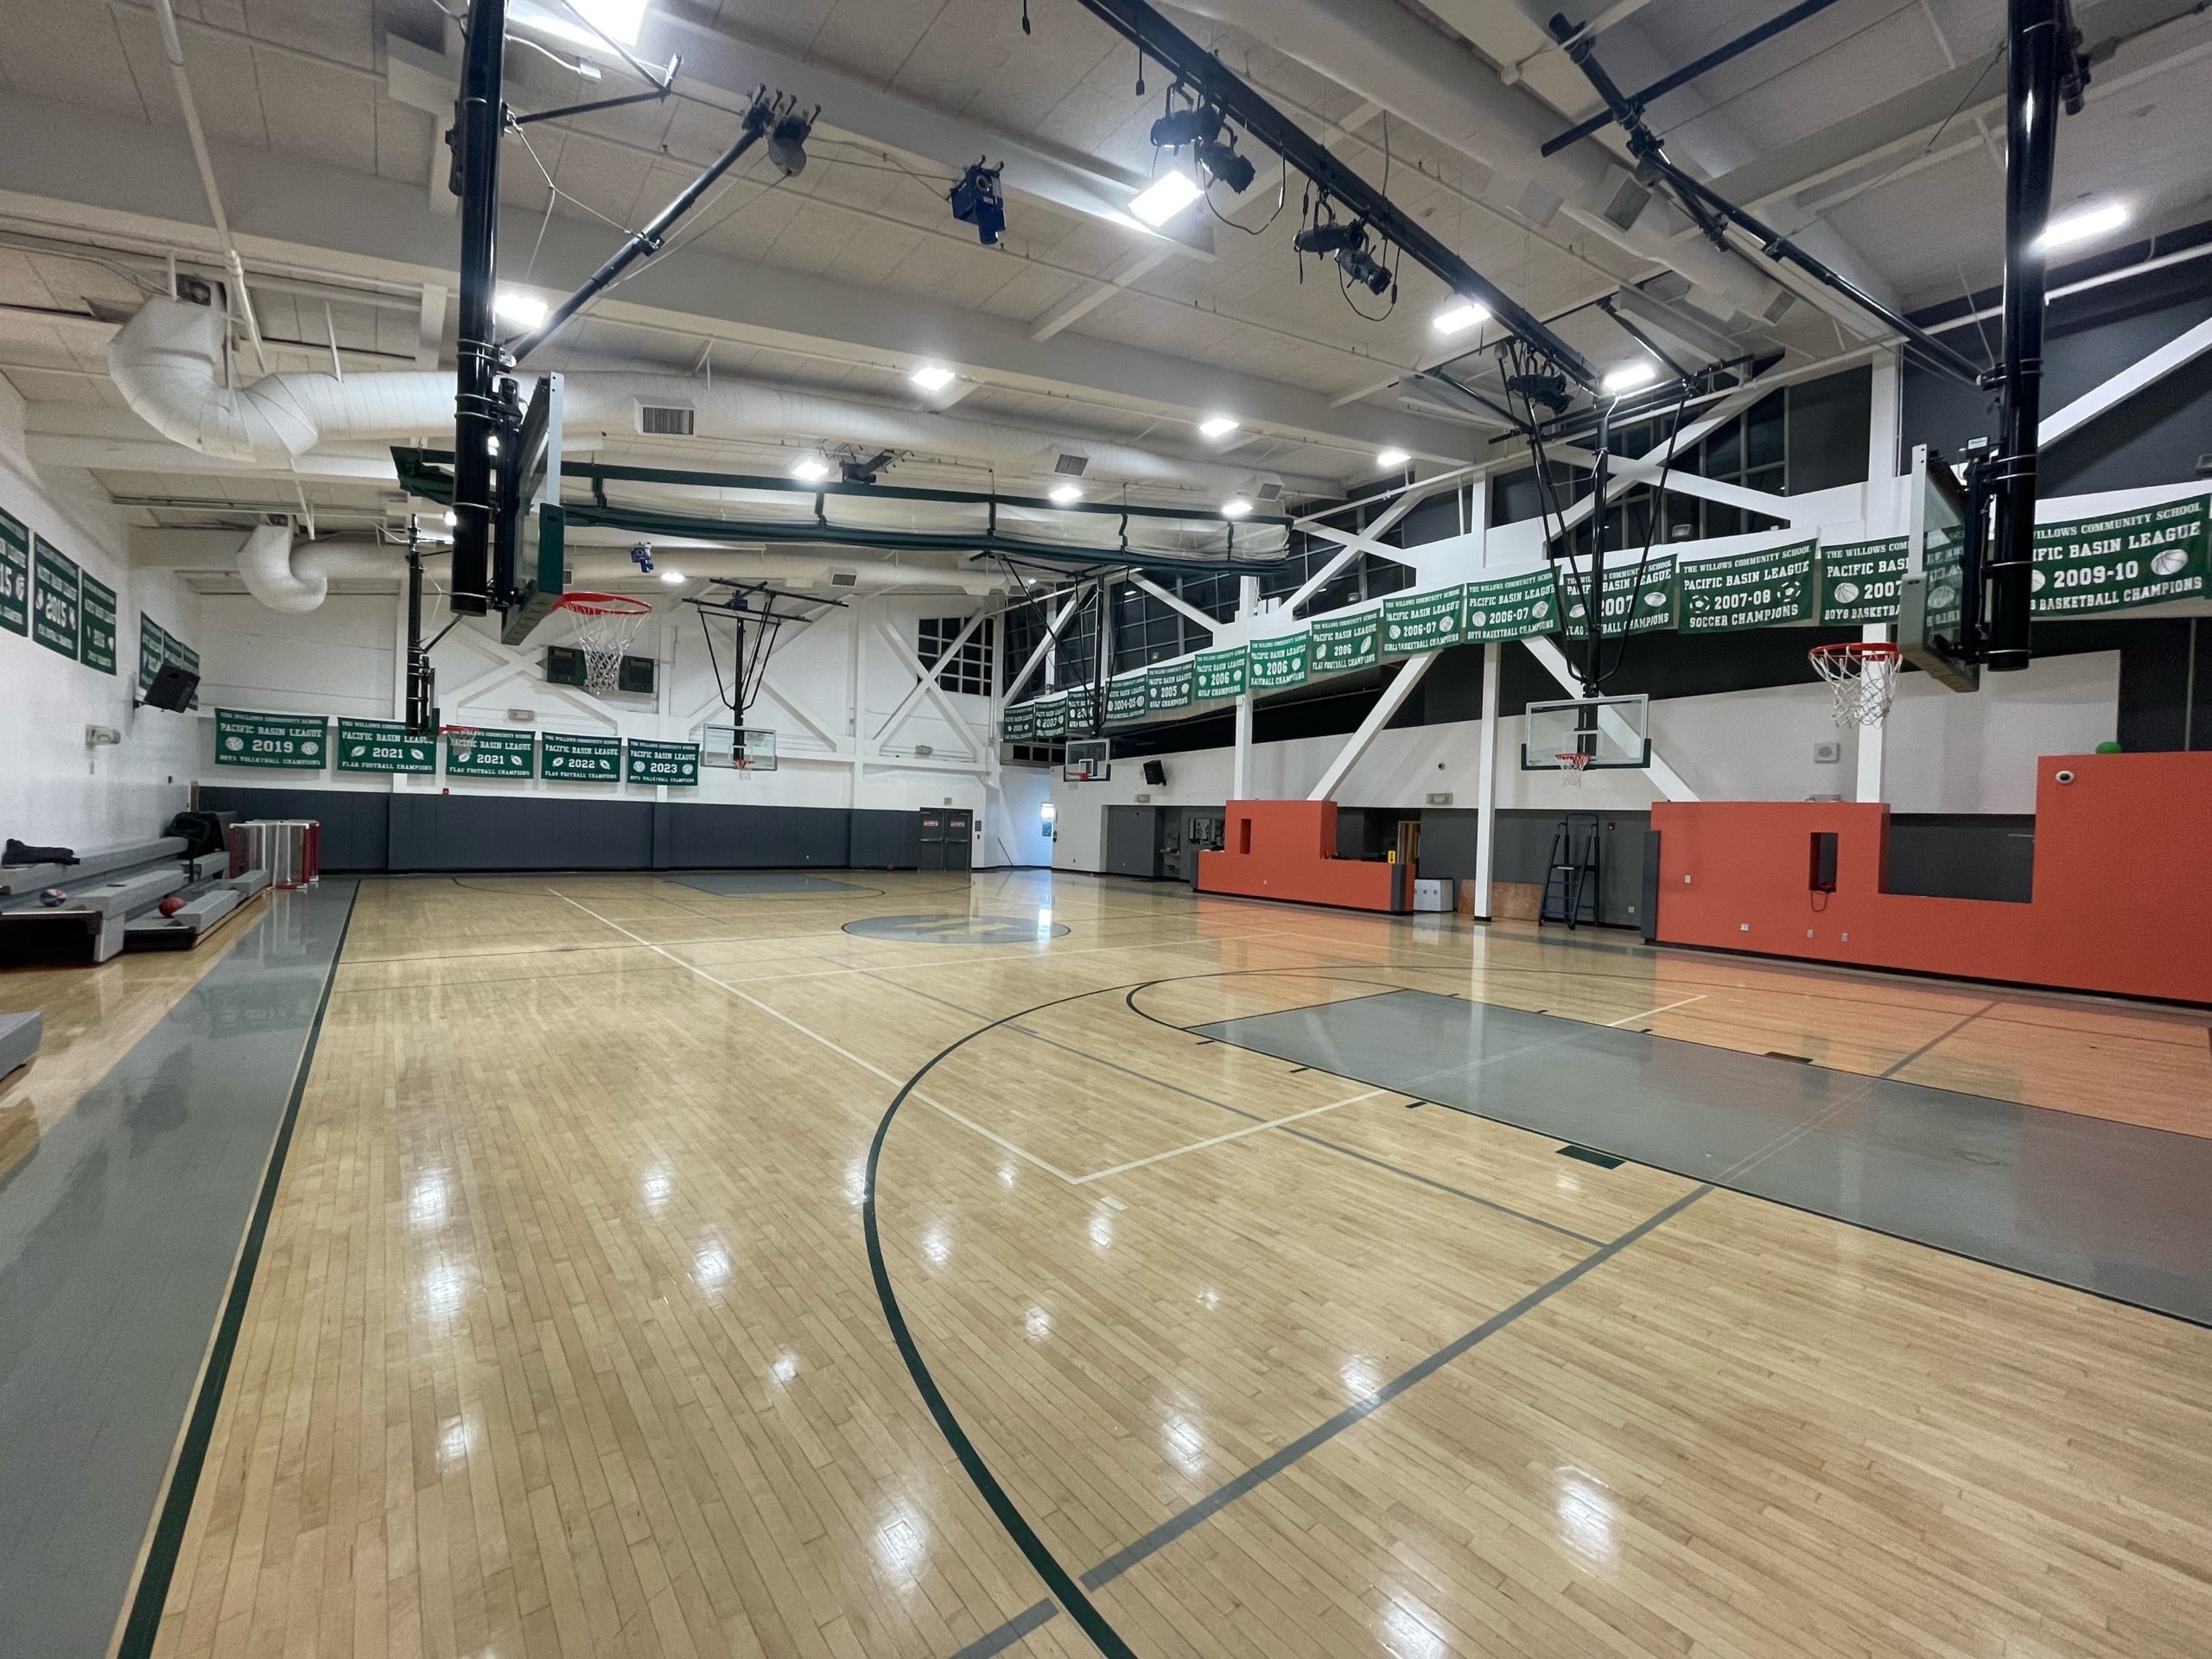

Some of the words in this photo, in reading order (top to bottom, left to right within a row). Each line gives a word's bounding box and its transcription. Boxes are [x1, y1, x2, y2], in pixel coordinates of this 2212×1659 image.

[2033, 526, 2077, 539] ILLOWS
[2081, 513, 2153, 534] COMMUNITY
[2156, 502, 2202, 521] SCHOOL
[2069, 538, 2121, 558] BASIN
[2128, 521, 2201, 549] LEAGUE
[1700, 562, 1732, 571] WILLOWS
[1735, 552, 1779, 567] COMMUNITY
[1782, 545, 1810, 558] SCHOOL
[1826, 550, 1843, 559] THE
[1846, 545, 1886, 557] WILLOWS
[1649, 560, 1672, 572] SCHOOL
[1827, 563, 1874, 577] PACIFIC
[1684, 577, 1722, 590] PACIFIC
[1726, 571, 1760, 586] BASIN
[1764, 561, 1809, 580] LEAGUE
[2054, 561, 2138, 588] 2009-10
[1505, 577, 1536, 588] COMMUNITY
[1602, 578, 1630, 592] BASIN
[1470, 596, 1496, 607] PACIFIC
[1499, 592, 1522, 604] BASIN
[1525, 584, 1555, 600] LEAGUE
[1714, 589, 1771, 610] 2007-08
[2040, 591, 2119, 611] BASKETBALL
[2124, 576, 2202, 602] CHAMPIONS
[1386, 612, 1409, 621] PACIFIC
[1411, 608, 1430, 619] BASIN
[1433, 601, 1460, 615] LEAGUE
[1489, 607, 1529, 624] 2006-07
[1690, 615, 1727, 628] SOCCER
[1732, 604, 1798, 625] CHAMPIONS
[1825, 609, 1848, 620] BOYS
[1313, 633, 1333, 641] PACIFIC
[1335, 630, 1352, 639] BASIN
[1354, 624, 1377, 636] LEAGUE
[1404, 622, 1436, 637] 2006-07
[1468, 631, 1481, 639] BOYS
[1483, 627, 1518, 638] BASKETBALL
[1519, 620, 1553, 634] CHAMPIONS
[1334, 644, 1352, 656] 2006
[1267, 660, 1287, 675] 2006
[1211, 672, 1229, 686] 2006
[1161, 686, 1177, 698] 2005
[220, 723, 254, 733] PACIFIC
[258, 727, 285, 735] BASIN
[289, 729, 322, 737] LEAGUE
[342, 732, 373, 740] PACIFIC
[376, 734, 401, 742] BASIN
[252, 739, 293, 753] 2019
[373, 748, 403, 758] 2021
[545, 744, 570, 753] PACIFIC
[477, 754, 504, 764] 2021
[569, 759, 595, 768] 2022
[651, 763, 677, 773] 2023
